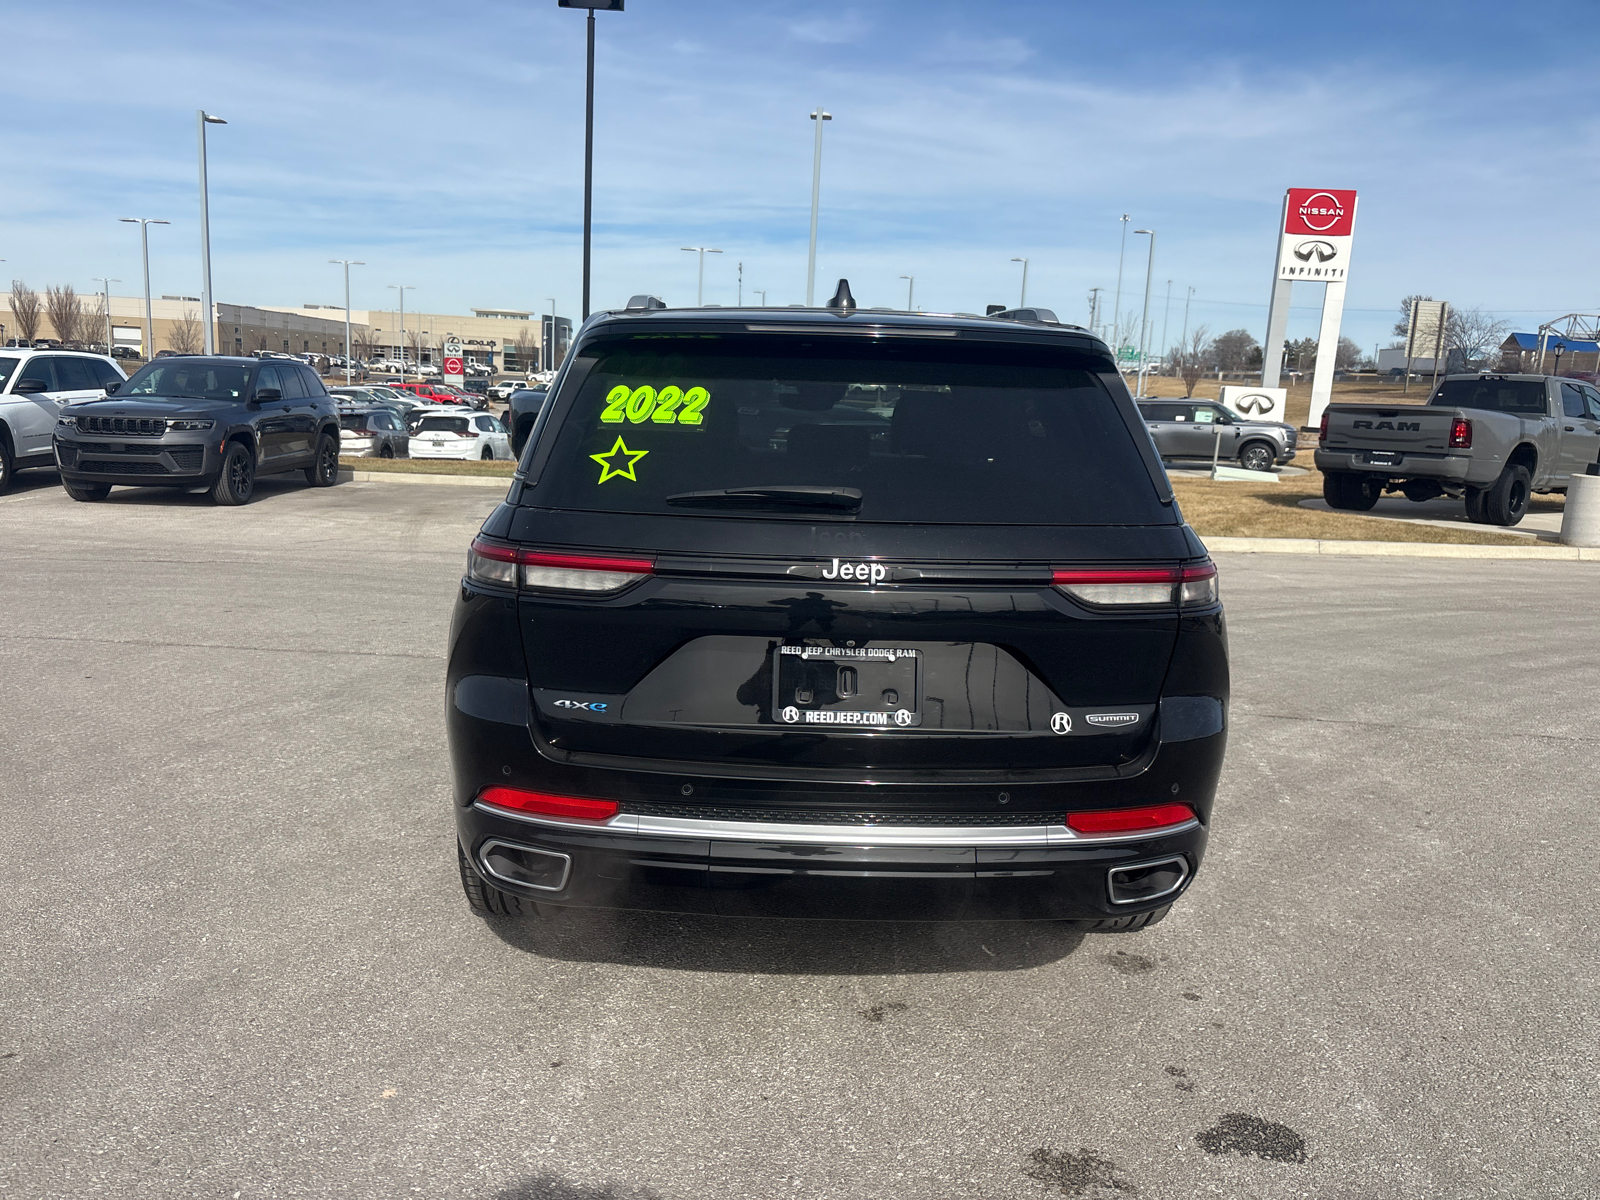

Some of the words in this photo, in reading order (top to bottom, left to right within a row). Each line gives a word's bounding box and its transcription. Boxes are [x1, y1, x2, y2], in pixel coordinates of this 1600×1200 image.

[1299, 207, 1344, 216] NISSAN
[1282, 266, 1344, 277] INFINITI
[600, 385, 710, 425] 2022
[1353, 420, 1420, 432] RAM
[822, 558, 886, 585] Jeep
[781, 646, 801, 655] REED
[804, 646, 823, 656] JEEP
[825, 647, 866, 657] CHRYSLER
[868, 648, 895, 657] DODGE
[896, 649, 916, 658] RAM
[806, 711, 887, 725] REEDJEEP.COM
